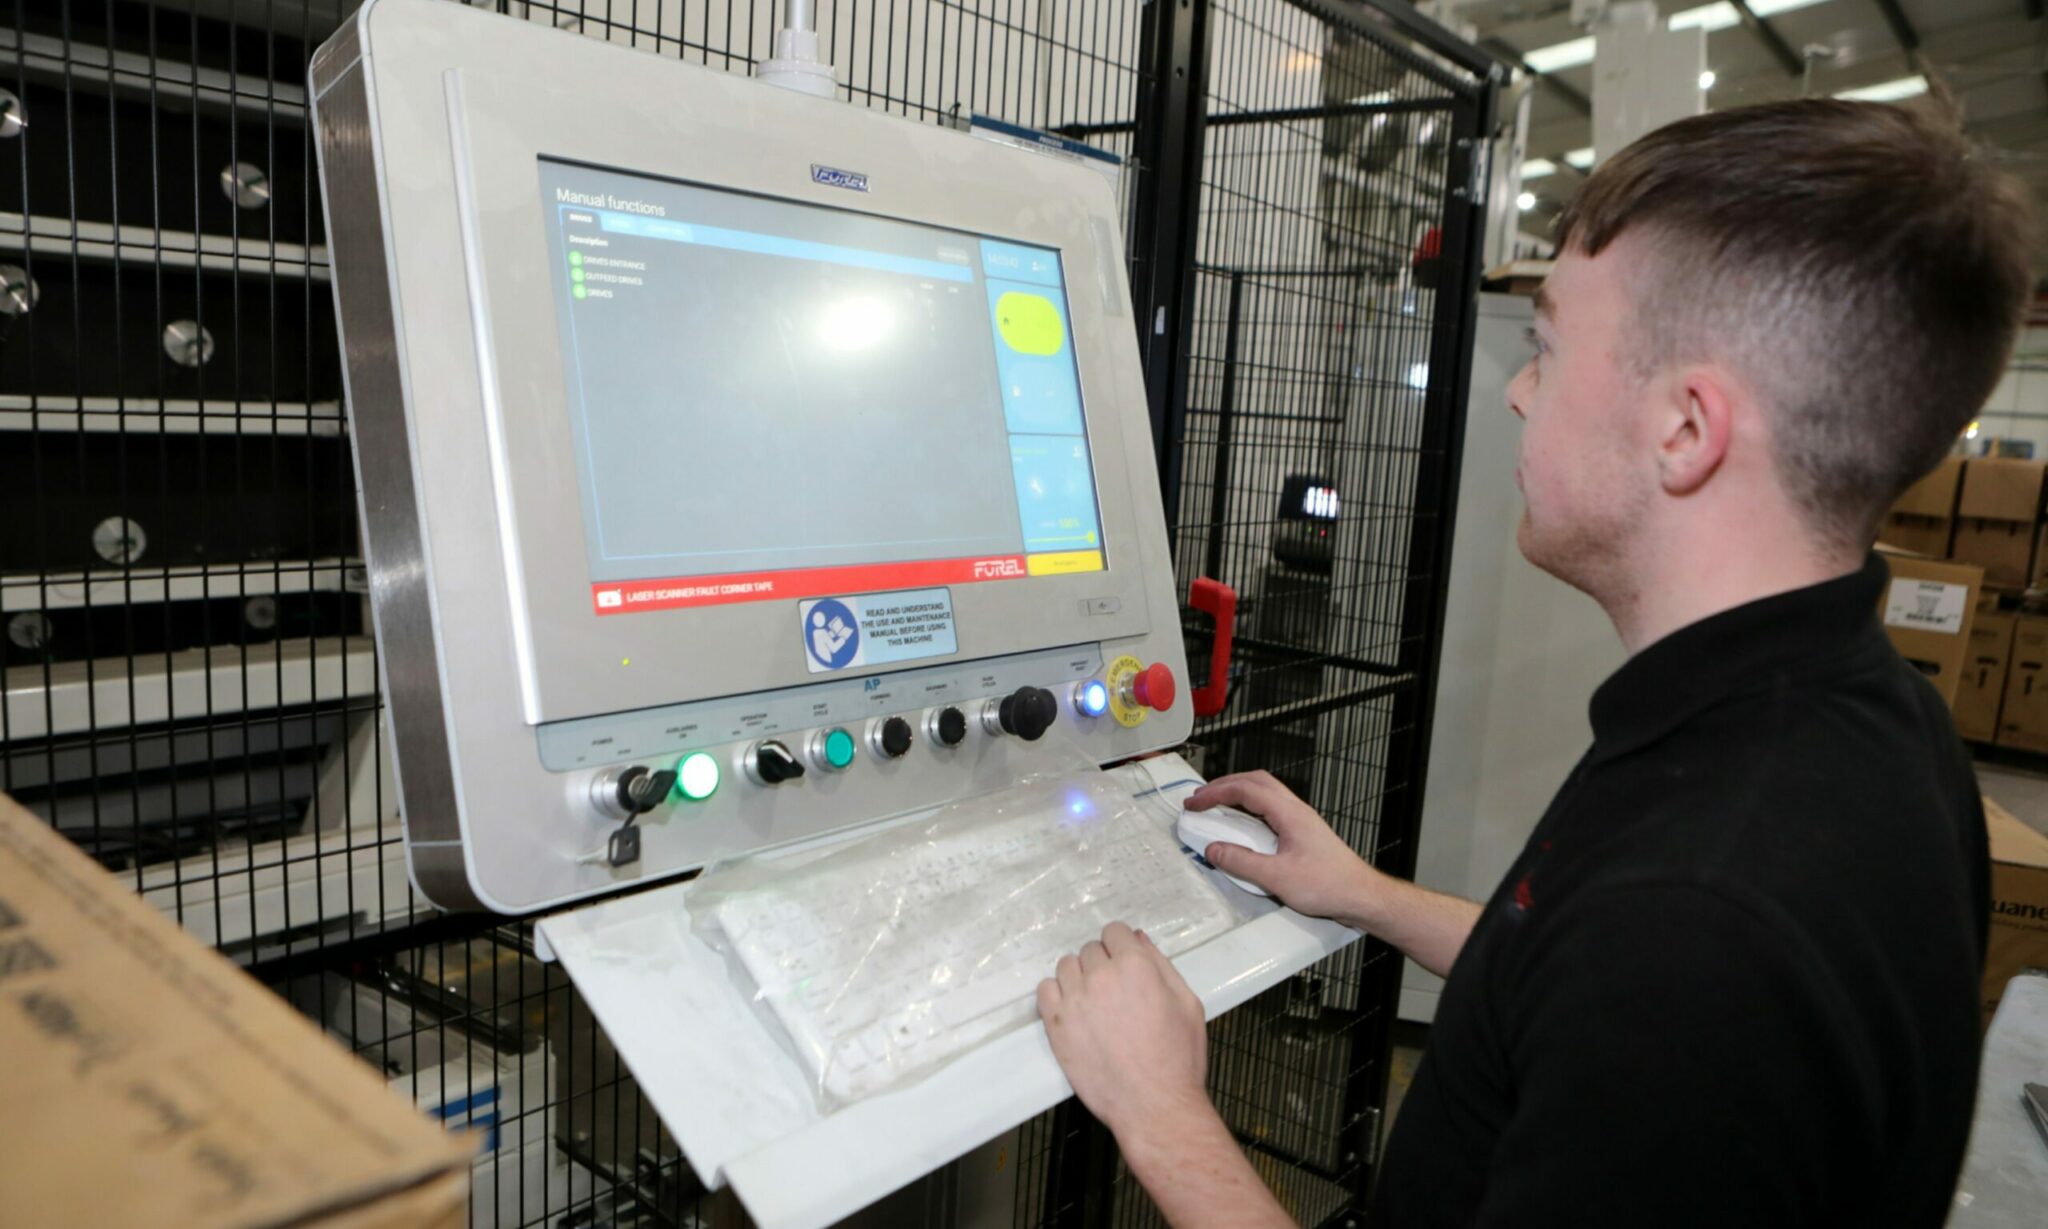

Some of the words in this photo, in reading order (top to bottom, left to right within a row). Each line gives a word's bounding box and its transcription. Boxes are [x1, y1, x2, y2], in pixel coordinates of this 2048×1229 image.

[556, 187, 606, 208] Manual
[607, 194, 666, 216] functions
[568, 234, 609, 247] Description
[583, 255, 609, 266] DRIVES
[609, 258, 646, 271] ENTRANCE
[617, 275, 643, 286] DRIVES
[587, 288, 613, 299] DRIVES
[974, 559, 1025, 578] FOREL
[626, 591, 654, 603] LASER
[655, 588, 696, 600] SCANNER
[697, 585, 720, 597] FAULT
[720, 583, 753, 595] CORNER
[754, 581, 774, 592] TAPE
[865, 608, 885, 618] READ
[886, 606, 900, 616] AND
[901, 602, 944, 614] UNDERSTAND
[861, 620, 876, 629] THE
[876, 618, 890, 627] USE
[891, 617, 905, 626] AND
[906, 611, 951, 623] MAINTENANCE
[869, 628, 898, 639] MANUAL
[899, 625, 926, 636] BEFORE
[926, 622, 947, 633] USING
[887, 637, 903, 647] THIS
[903, 634, 933, 646] MACHINE
[864, 678, 881, 692] AP
[1990, 899, 2048, 921] uane
